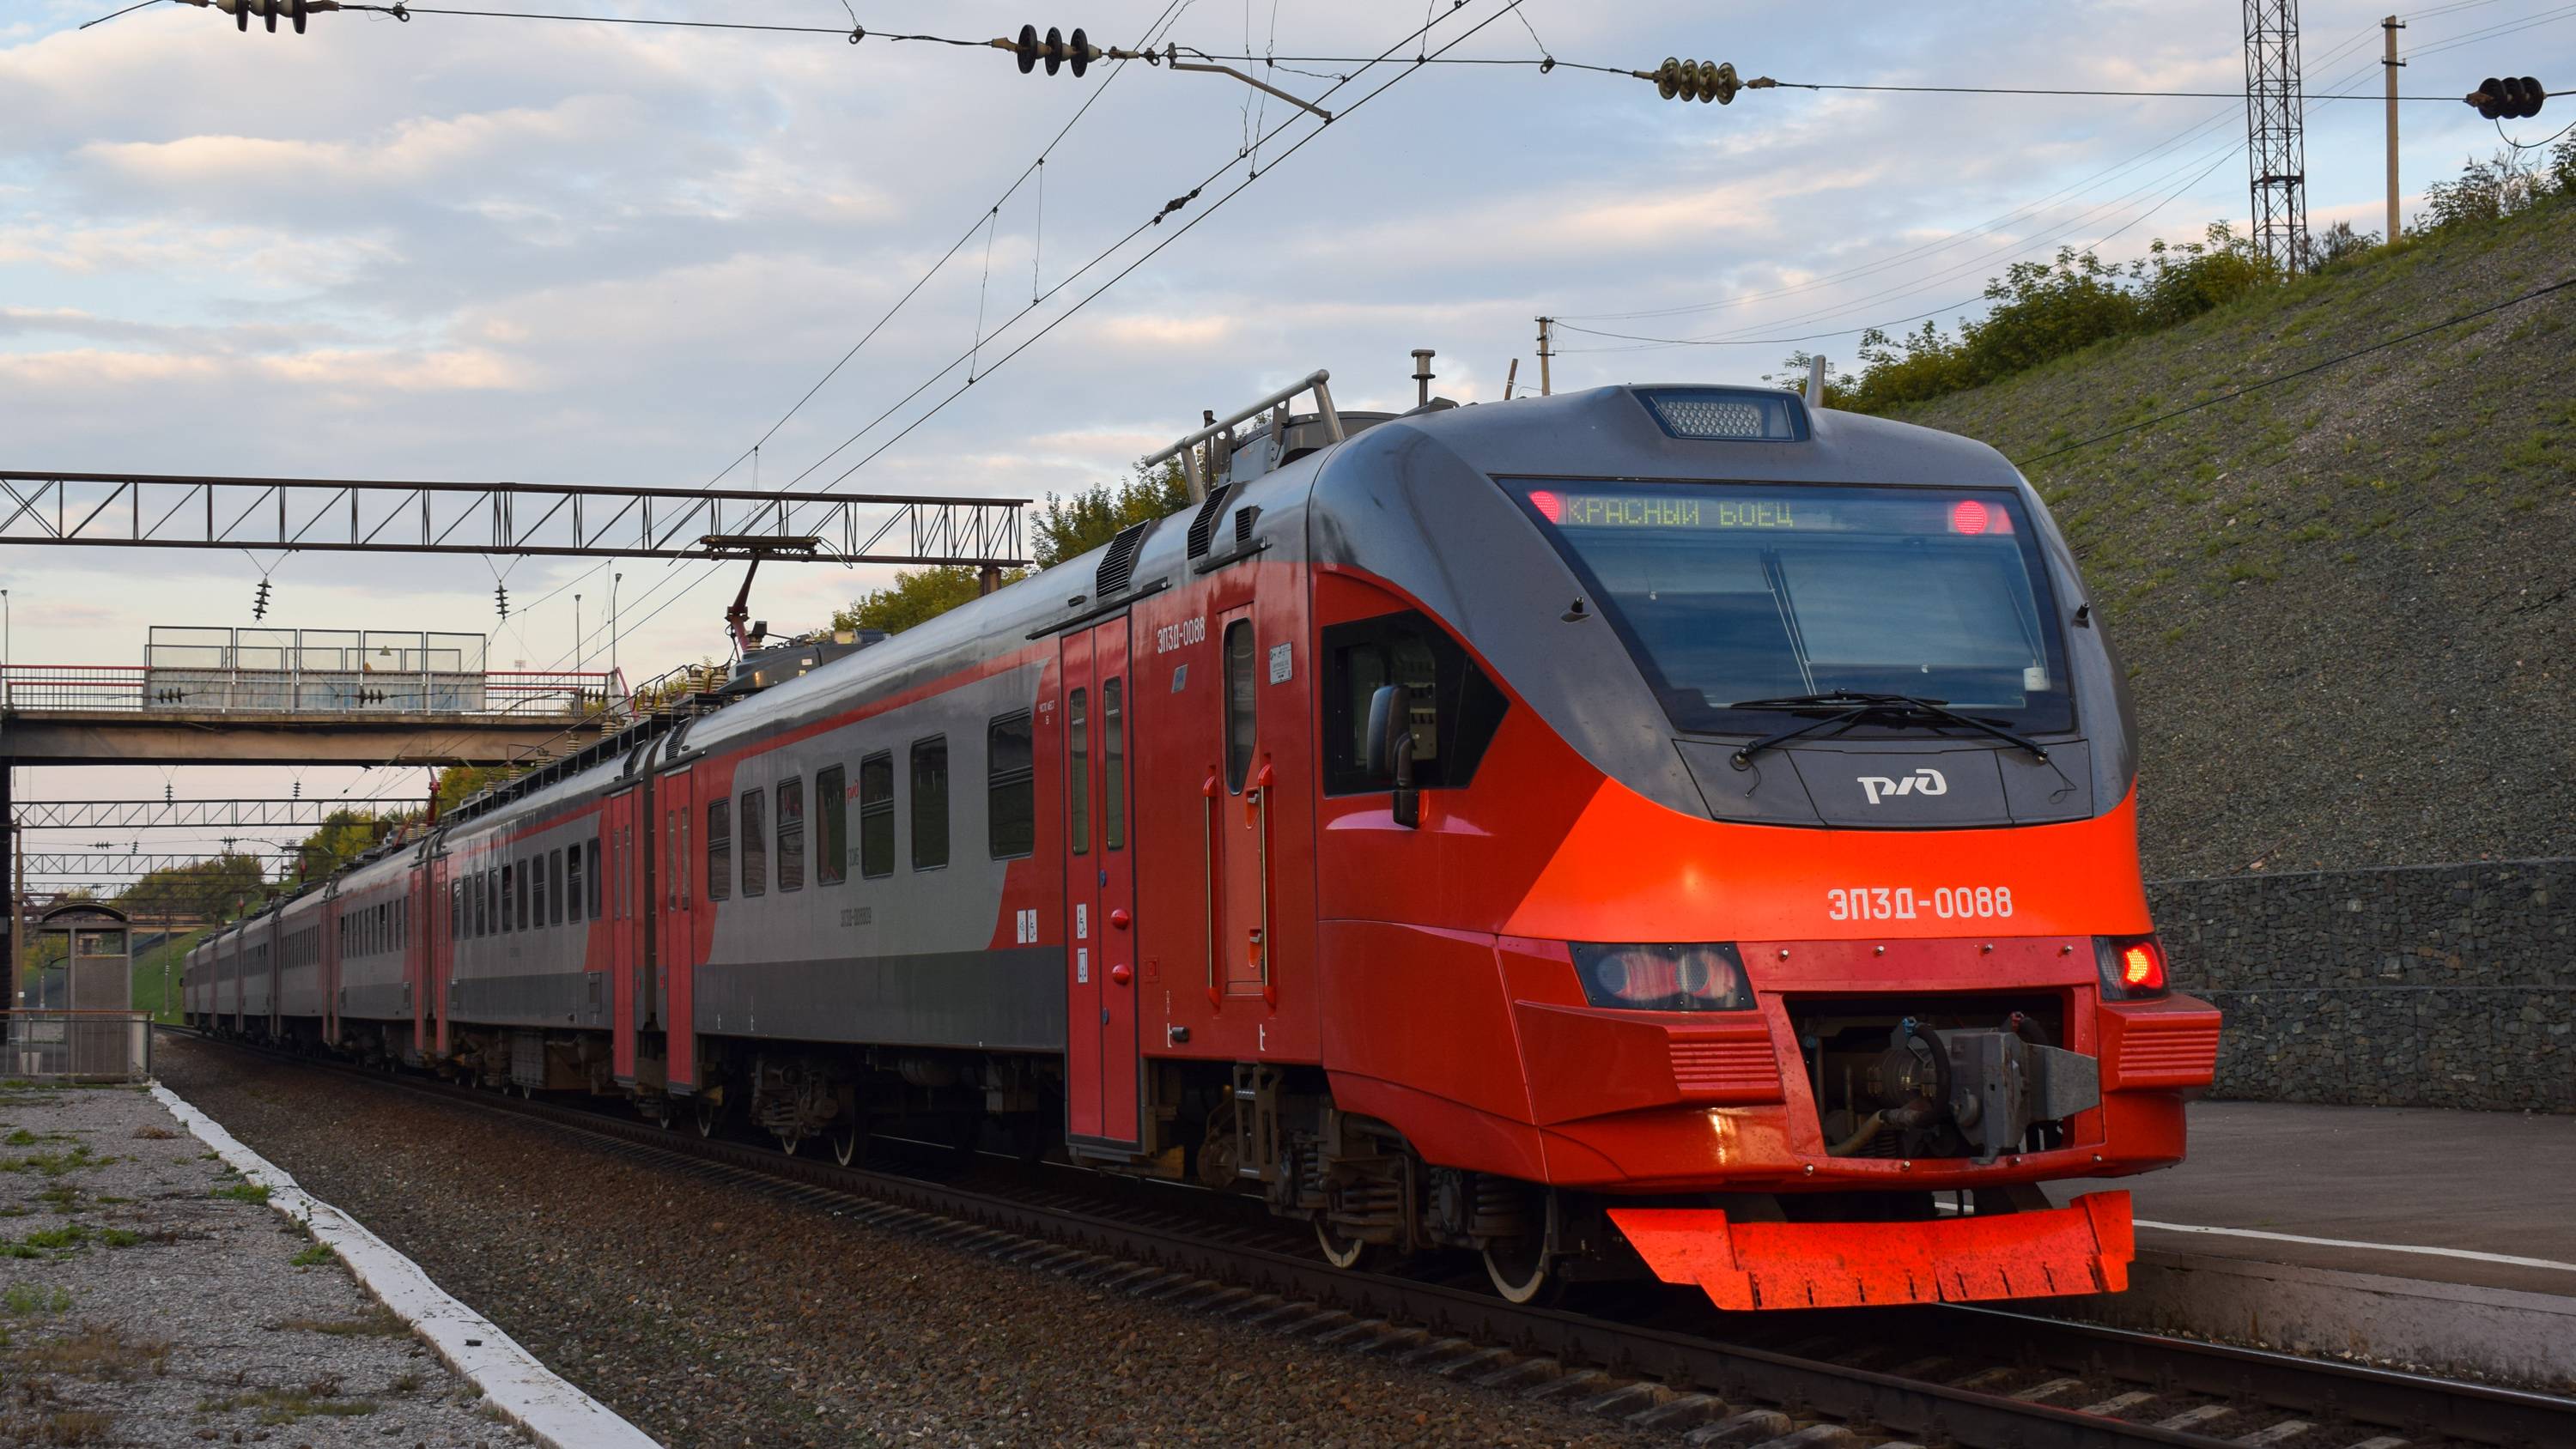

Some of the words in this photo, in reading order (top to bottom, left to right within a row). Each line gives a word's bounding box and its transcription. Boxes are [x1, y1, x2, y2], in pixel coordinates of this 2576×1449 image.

[1568, 497, 1699, 525] КРАСНЫЙ
[1719, 501, 1794, 528] БОЕЦ
[1157, 616, 1206, 654] ЭП3Д-0088
[1827, 886, 2014, 921] ЭП3Д-0088
